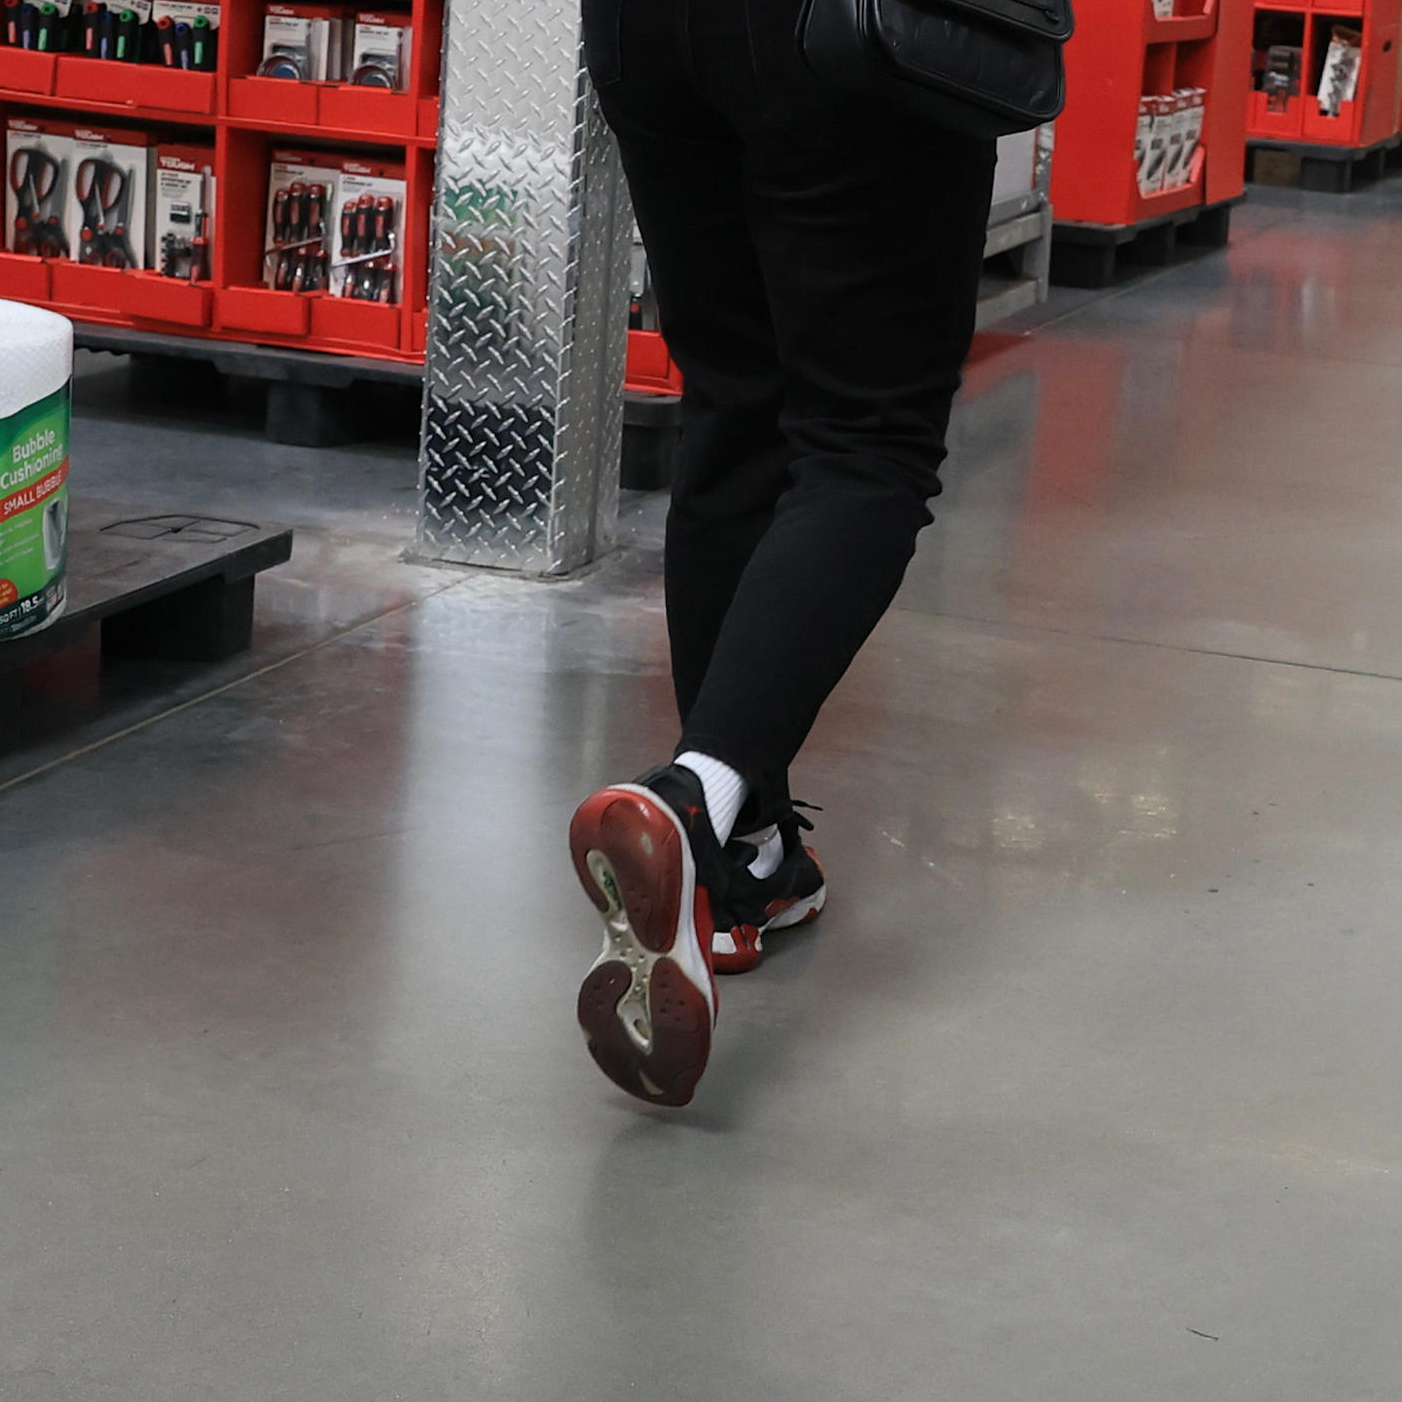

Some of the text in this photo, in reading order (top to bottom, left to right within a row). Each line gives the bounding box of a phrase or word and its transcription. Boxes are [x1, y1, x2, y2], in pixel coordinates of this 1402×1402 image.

[12, 428, 57, 464] Bubble
[0, 443, 64, 491] Cushioning
[3, 491, 35, 515] SMALL
[10, 608, 20, 621] FT
